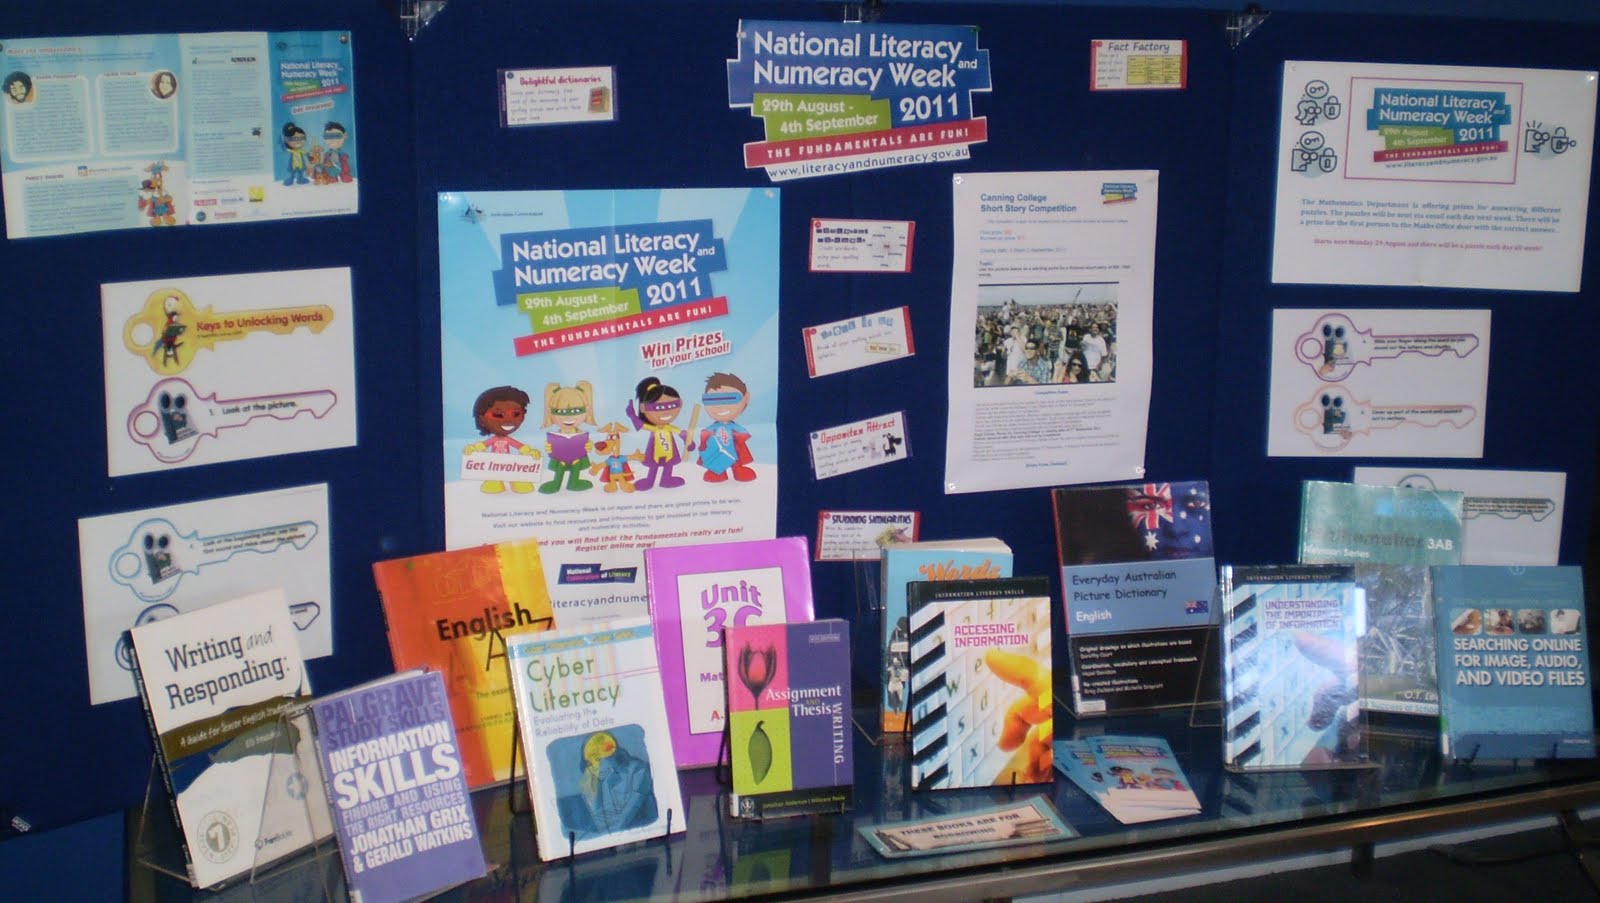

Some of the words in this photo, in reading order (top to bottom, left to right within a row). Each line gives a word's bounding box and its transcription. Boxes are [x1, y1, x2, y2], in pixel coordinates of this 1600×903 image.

[754, 31, 860, 57] National
[870, 34, 962, 63] Literacy
[1108, 42, 1128, 51] Fact
[1133, 42, 1169, 53] Factory
[958, 59, 977, 69] and
[520, 76, 556, 86] Delightful
[558, 75, 601, 83] dictionaries
[754, 60, 882, 91] Numeracy
[890, 62, 955, 87] Week
[762, 99, 792, 112] 29th
[797, 100, 845, 115] August
[900, 93, 958, 121] 2011
[1380, 94, 1438, 107] National
[1443, 96, 1496, 111] Literacy
[780, 120, 801, 134] 4th
[806, 115, 878, 133] September
[1380, 109, 1450, 124] Numeracy
[1454, 110, 1492, 124] Week
[1403, 128, 1428, 136] August
[1408, 136, 1447, 145] September
[1459, 128, 1493, 142] 2011
[768, 147, 791, 159] THE
[799, 136, 902, 155] FUNDAMENTALS
[911, 132, 933, 143] ARE
[941, 128, 969, 139] FUN!
[768, 146, 968, 178] www.literacyandnumeracy.gov.au
[981, 194, 1014, 203] Canning
[1017, 194, 1047, 203] College
[981, 204, 1003, 212] Short
[1005, 204, 1026, 213] Story
[513, 235, 606, 261] National
[614, 232, 699, 255] Literacy
[697, 245, 715, 257] and
[514, 261, 629, 286] Numeracy
[633, 253, 696, 277] Week
[524, 295, 552, 309] 29th
[556, 293, 597, 308] August
[647, 277, 702, 306] 2011
[197, 321, 220, 333] Keys
[224, 320, 234, 329] to
[238, 316, 288, 328] Unlocking
[292, 313, 323, 323] Words
[543, 314, 562, 327] 4th
[565, 301, 629, 324] September
[533, 337, 554, 348] THE
[561, 317, 652, 342] FUNDAMENTALS
[659, 312, 680, 323] ARE
[686, 306, 712, 317] FUN!
[641, 341, 671, 359] Win
[676, 331, 721, 354] Prizes
[652, 356, 665, 367] for
[669, 352, 692, 366] your
[695, 344, 729, 358] school!
[222, 407, 240, 415] Look
[268, 401, 297, 411] picture.
[821, 429, 863, 444] Opposites
[867, 418, 895, 432] Attract
[466, 461, 484, 470] Get
[489, 461, 540, 473] Involved!
[635, 532, 688, 540] fundamentals
[1428, 539, 1453, 551] 3AB
[919, 559, 1000, 582] Words
[1073, 575, 1119, 586] Everyday
[1125, 571, 1176, 582] Australian
[701, 580, 763, 610] Unit
[1074, 591, 1110, 600] Picture
[1116, 589, 1167, 599] Dictionary
[1266, 600, 1338, 609] UNDERSTANDING
[436, 603, 532, 641] English
[1076, 610, 1112, 623] English
[1280, 620, 1338, 628] INFORMATION
[954, 624, 1014, 635] ACCESSING
[166, 636, 244, 672] Writing
[246, 625, 272, 650] and
[955, 635, 1028, 647] INFORMATION
[1454, 639, 1528, 651] SEARCHING
[1533, 639, 1582, 651] ONLINE
[527, 657, 594, 686] Cyber
[1455, 655, 1480, 667] FOR
[1485, 656, 1531, 669] IMAGE,
[1535, 656, 1582, 669] AUDIO,
[165, 657, 289, 709] Responding:
[700, 672, 724, 682] Mat
[1456, 671, 1491, 685] AND
[1496, 671, 1544, 685] VIDEO
[1549, 671, 1584, 686] FILES
[322, 678, 441, 726] PALGRAVE
[530, 684, 620, 712] Literacy
[766, 686, 841, 702] Assignment
[534, 709, 580, 725] Evaluating
[583, 708, 597, 716] the
[711, 711, 724, 720] A.
[792, 702, 832, 717] Thesis
[187, 731, 207, 745] Guide
[221, 721, 241, 733] Senior
[243, 712, 265, 725] English
[327, 717, 381, 750] STUDY
[388, 702, 446, 730] SKILLS
[536, 722, 579, 736] Reliability
[582, 720, 590, 728] of
[593, 717, 615, 726] Data
[832, 702, 844, 763] WRITING
[329, 721, 450, 773] INFORMATION
[333, 744, 460, 810] SKILLS
[342, 800, 389, 824] FINDING
[394, 789, 418, 808] AND
[424, 778, 462, 798] USING
[345, 821, 365, 837] THE
[369, 811, 398, 829] RIGHT
[402, 791, 465, 819] RESOURCES
[352, 816, 427, 856] JONATHAN
[430, 804, 469, 826] GRIX
[902, 827, 934, 835] THESE
[938, 822, 972, 831] BOOKS
[999, 813, 1020, 822] FOR
[934, 828, 995, 839] BORROWING
[353, 856, 363, 873] &
[365, 841, 413, 869] GERALD
[416, 823, 473, 852] WATKINS
